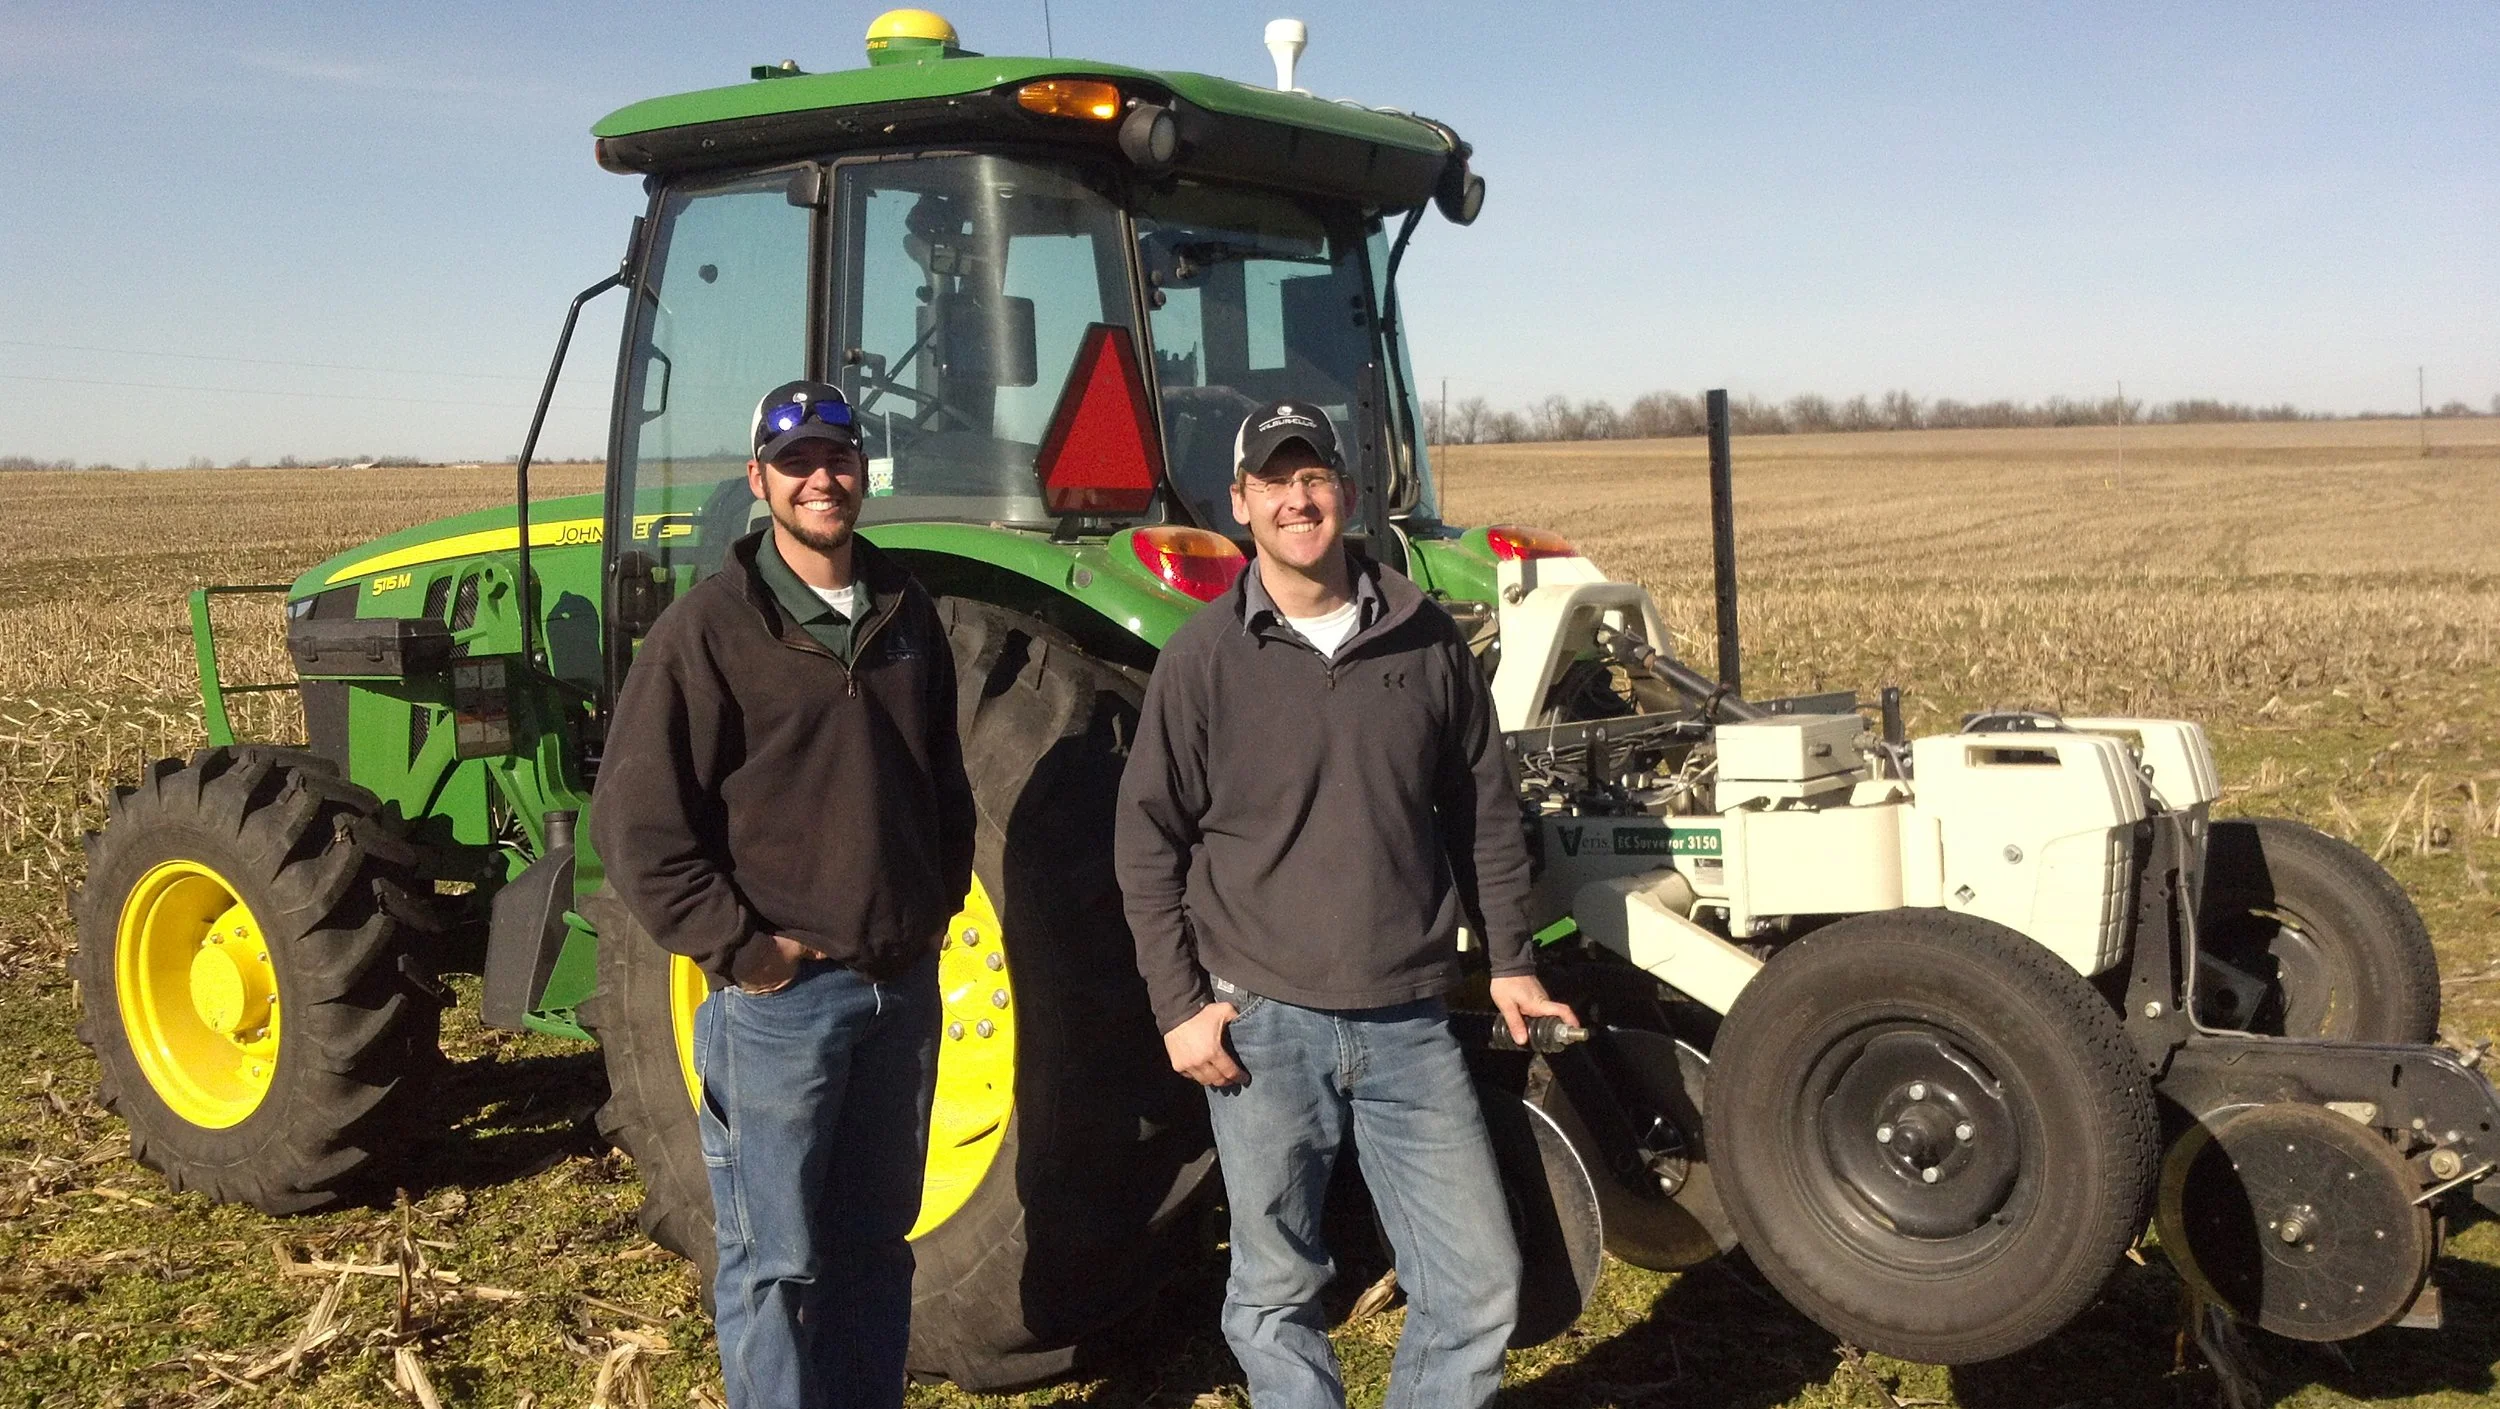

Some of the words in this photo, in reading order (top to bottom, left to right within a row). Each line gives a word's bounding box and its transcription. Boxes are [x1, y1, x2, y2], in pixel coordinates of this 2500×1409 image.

[1617, 835, 1631, 849] EC
[1634, 835, 1684, 853] Surveyor
[1687, 835, 1717, 850] 3150
